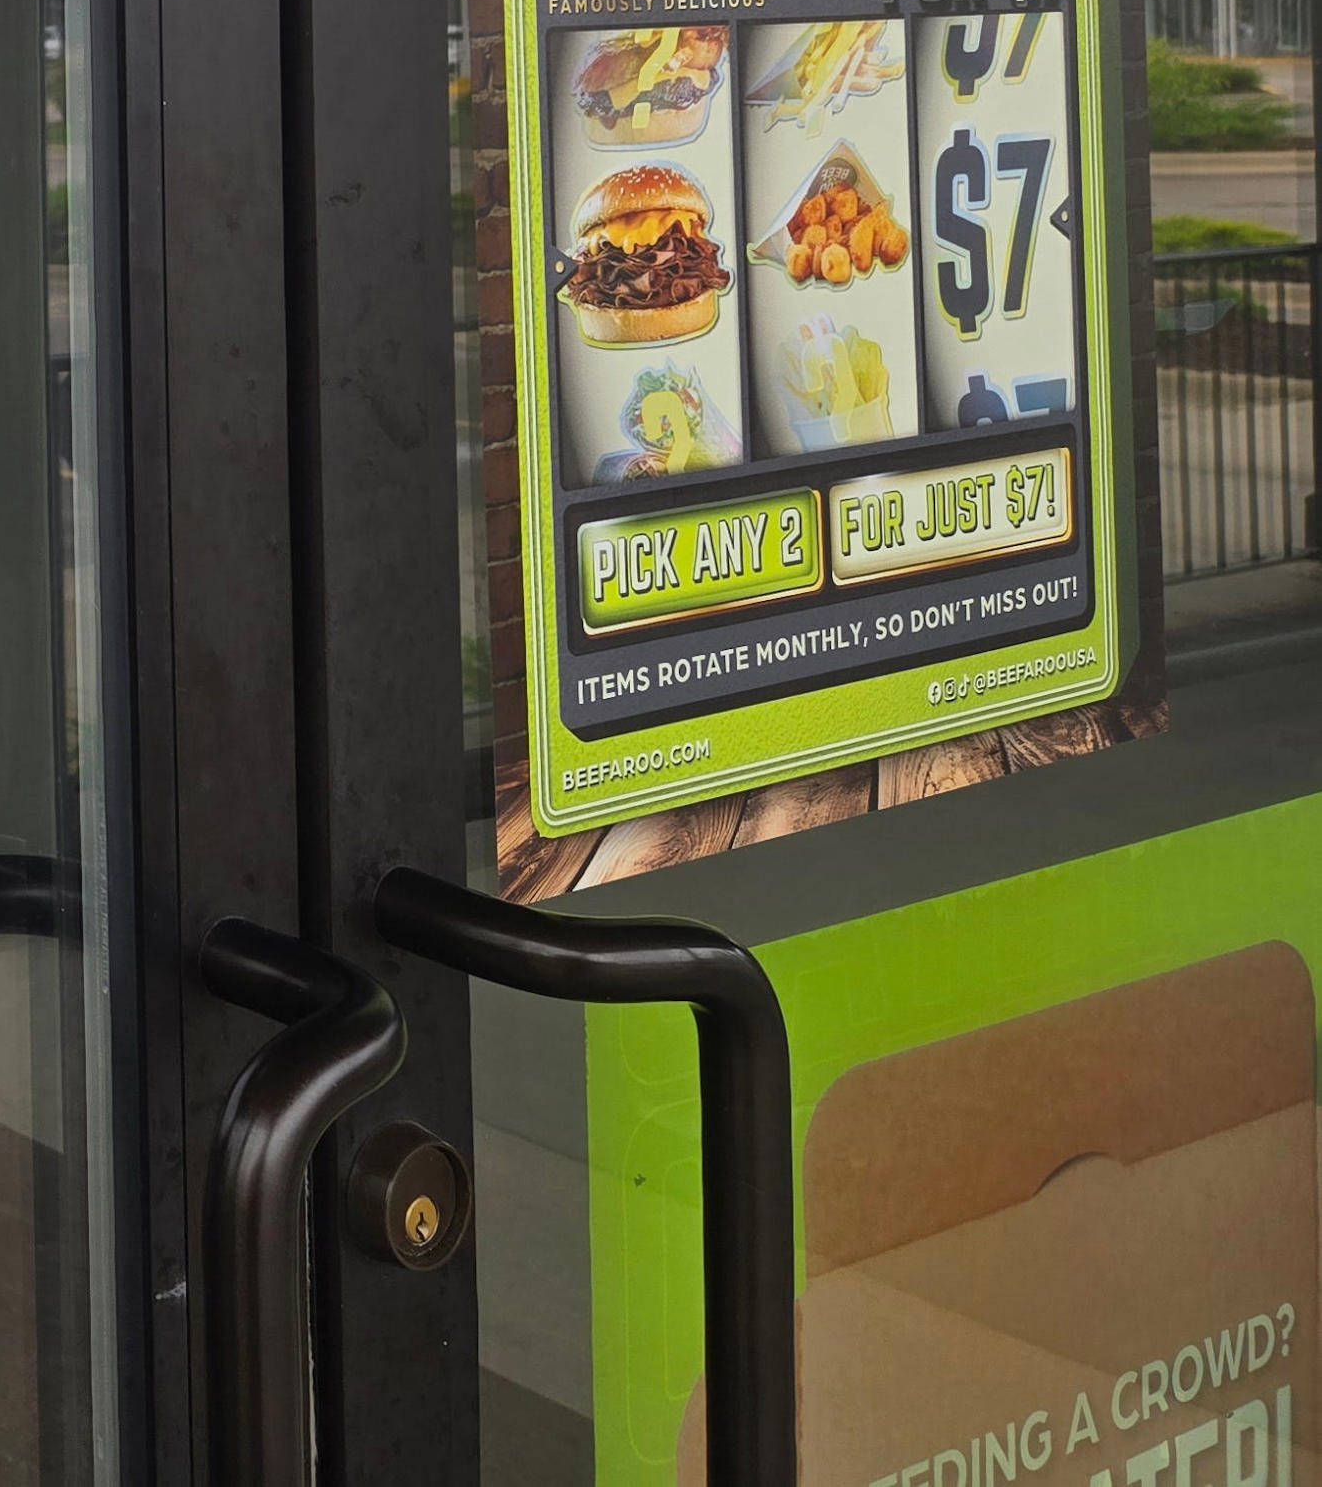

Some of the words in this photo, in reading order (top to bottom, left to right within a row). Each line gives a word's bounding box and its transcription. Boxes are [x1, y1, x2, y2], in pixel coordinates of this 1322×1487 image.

[935, 128, 1051, 334] $7
[592, 527, 679, 601] PICK
[692, 512, 768, 583] ANY
[780, 507, 803, 566] 2
[839, 490, 905, 556] FOR
[916, 473, 995, 541] JUST
[1006, 463, 1056, 528] $7!
[576, 666, 651, 706] ITEMS
[658, 645, 750, 688] ROTATE
[756, 621, 869, 667] MONTHLY,
[875, 613, 905, 641] SO
[910, 597, 975, 634] DON'T
[980, 586, 1027, 619] MISS
[1031, 575, 1078, 606] OUT!
[972, 646, 1098, 695] @BEEFAROOUSA
[562, 738, 711, 792] BEEFAROO.COM
[1066, 1392, 1100, 1455] A
[1111, 1302, 1296, 1430] CROWD?
